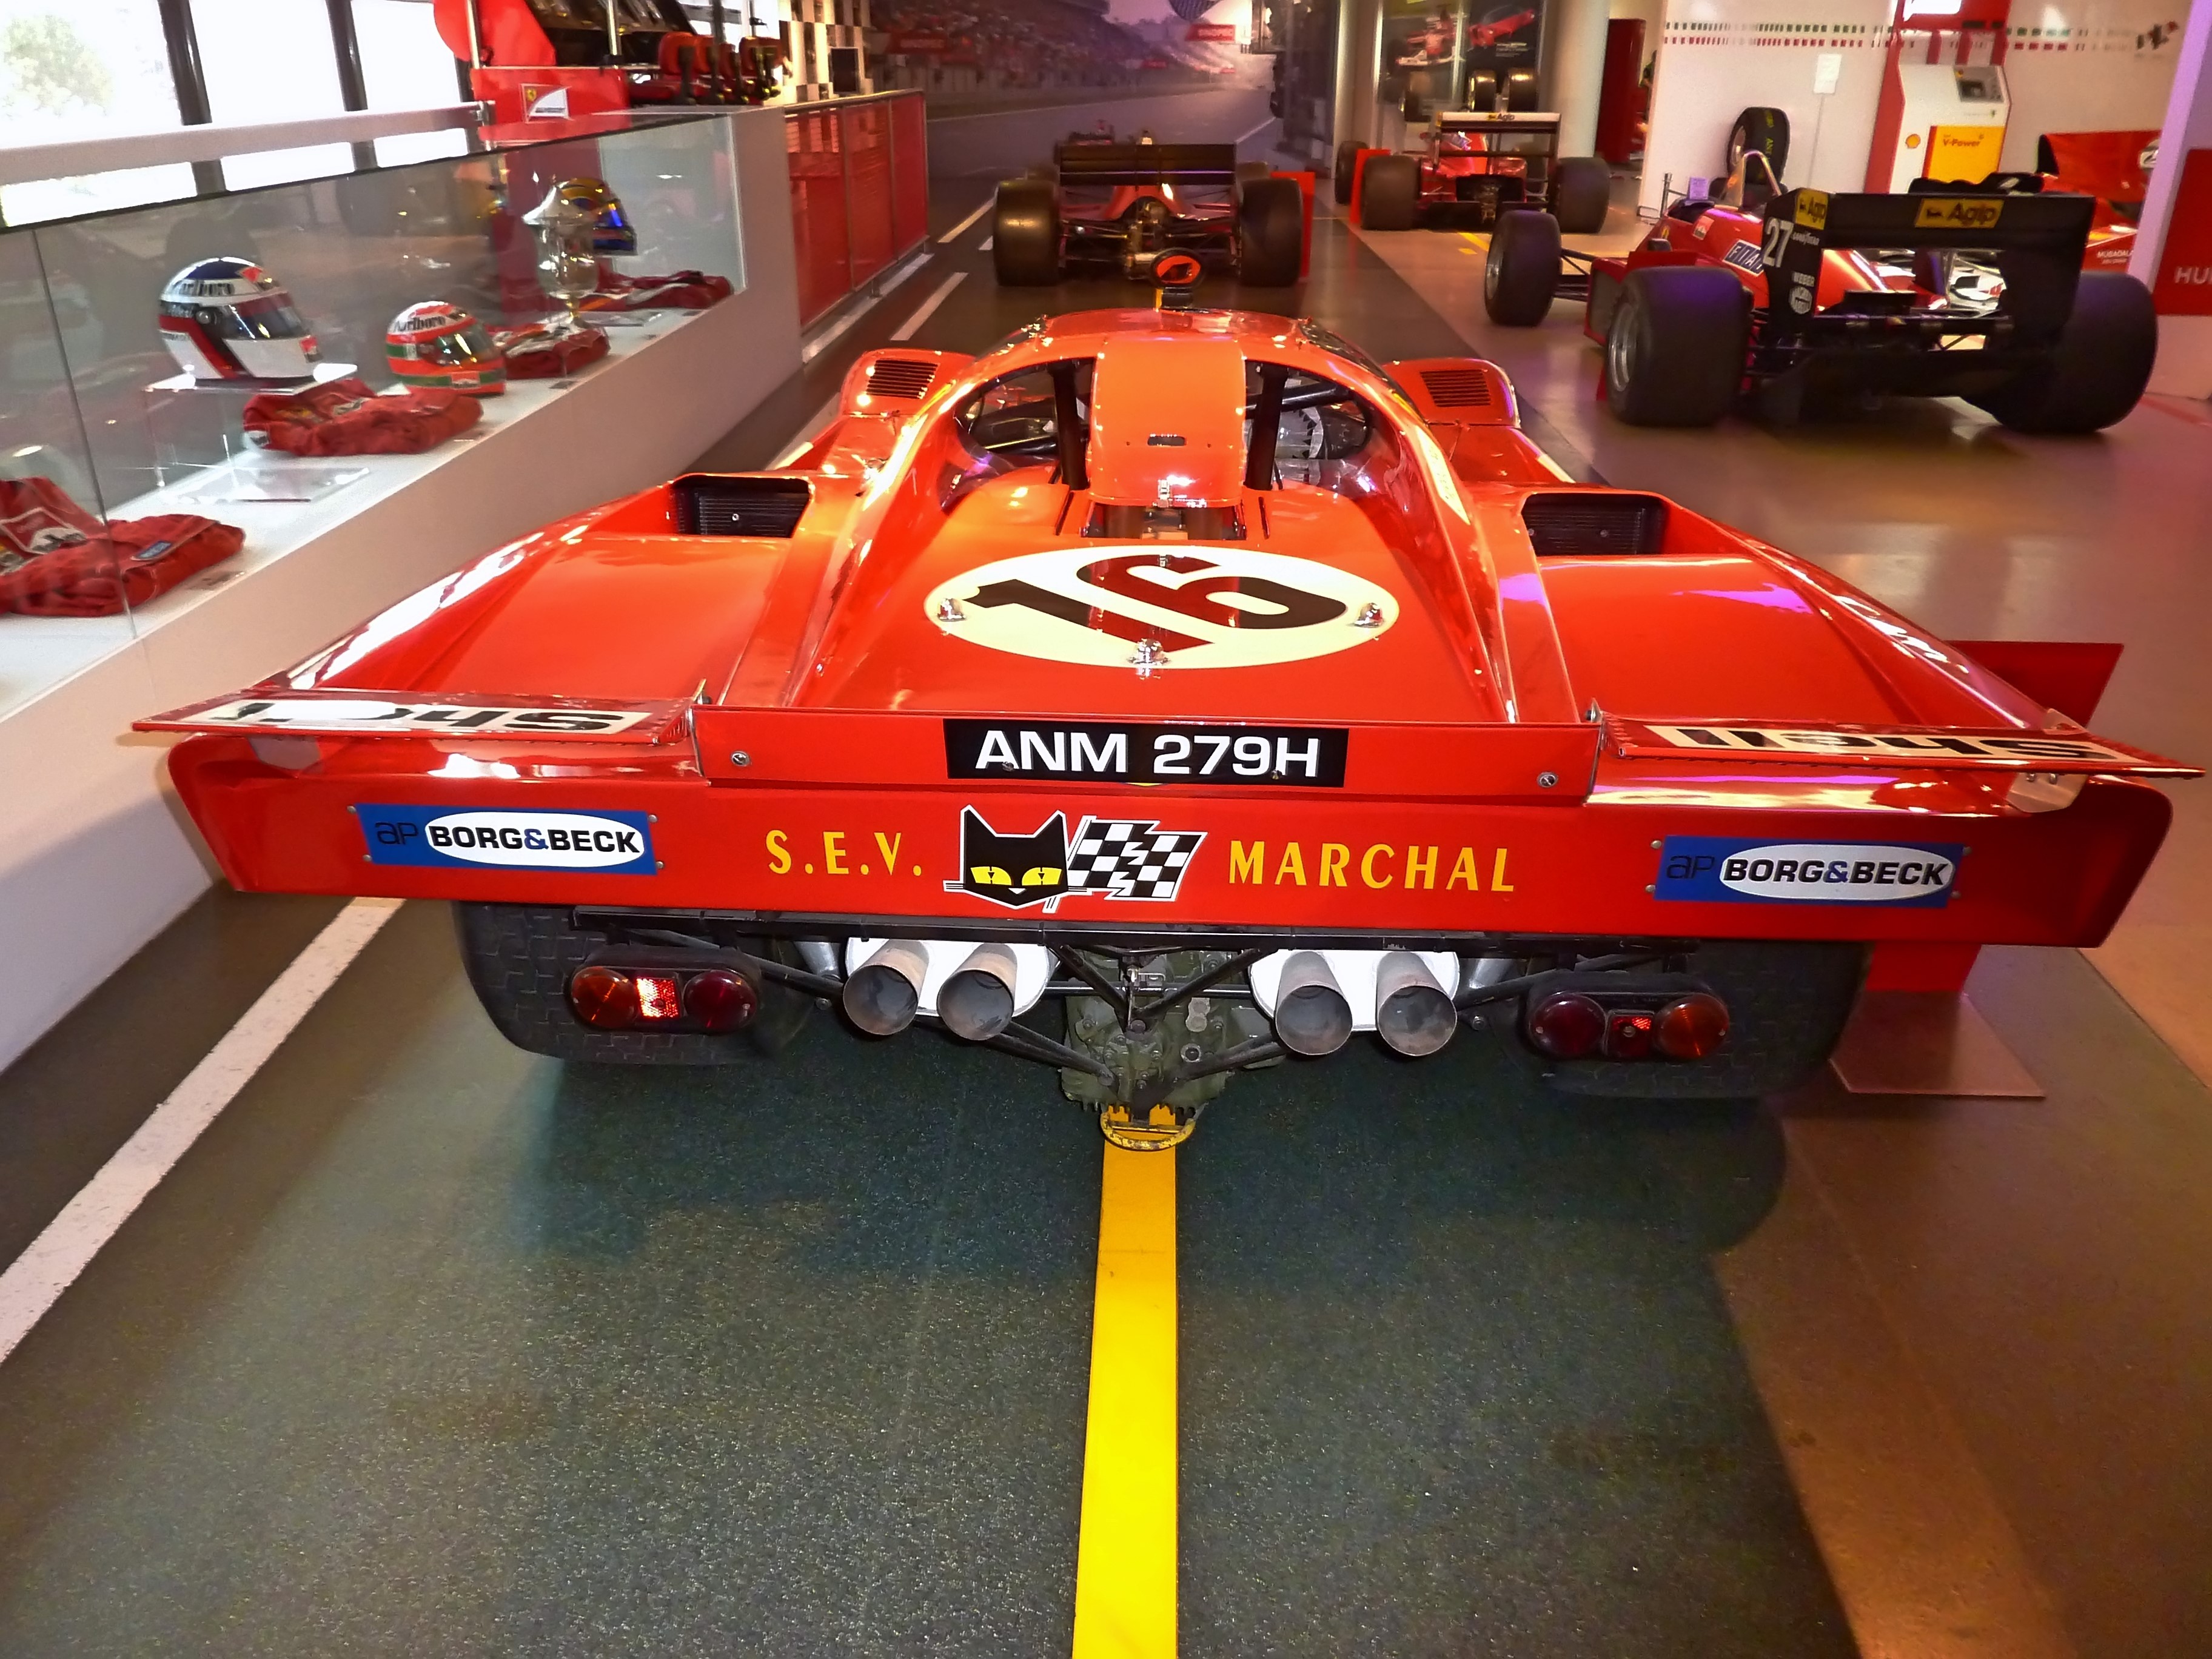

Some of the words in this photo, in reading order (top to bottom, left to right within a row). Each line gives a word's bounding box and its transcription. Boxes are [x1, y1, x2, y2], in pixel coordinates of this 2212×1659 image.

[1943, 138, 1981, 147] V-Power
[1946, 202, 1997, 227] Agip
[1763, 217, 1794, 268] 27
[2174, 266, 2212, 285] HU
[962, 554, 1347, 652] 16
[976, 730, 1127, 773] ANM
[1153, 734, 1319, 777] 279H
[1676, 729, 2118, 760] Shell
[428, 826, 640, 853] BORG&BECK
[766, 830, 922, 876] S.E.V.
[1230, 840, 1513, 891] MARCHAL
[1723, 859, 1949, 886] BORG&BECK
